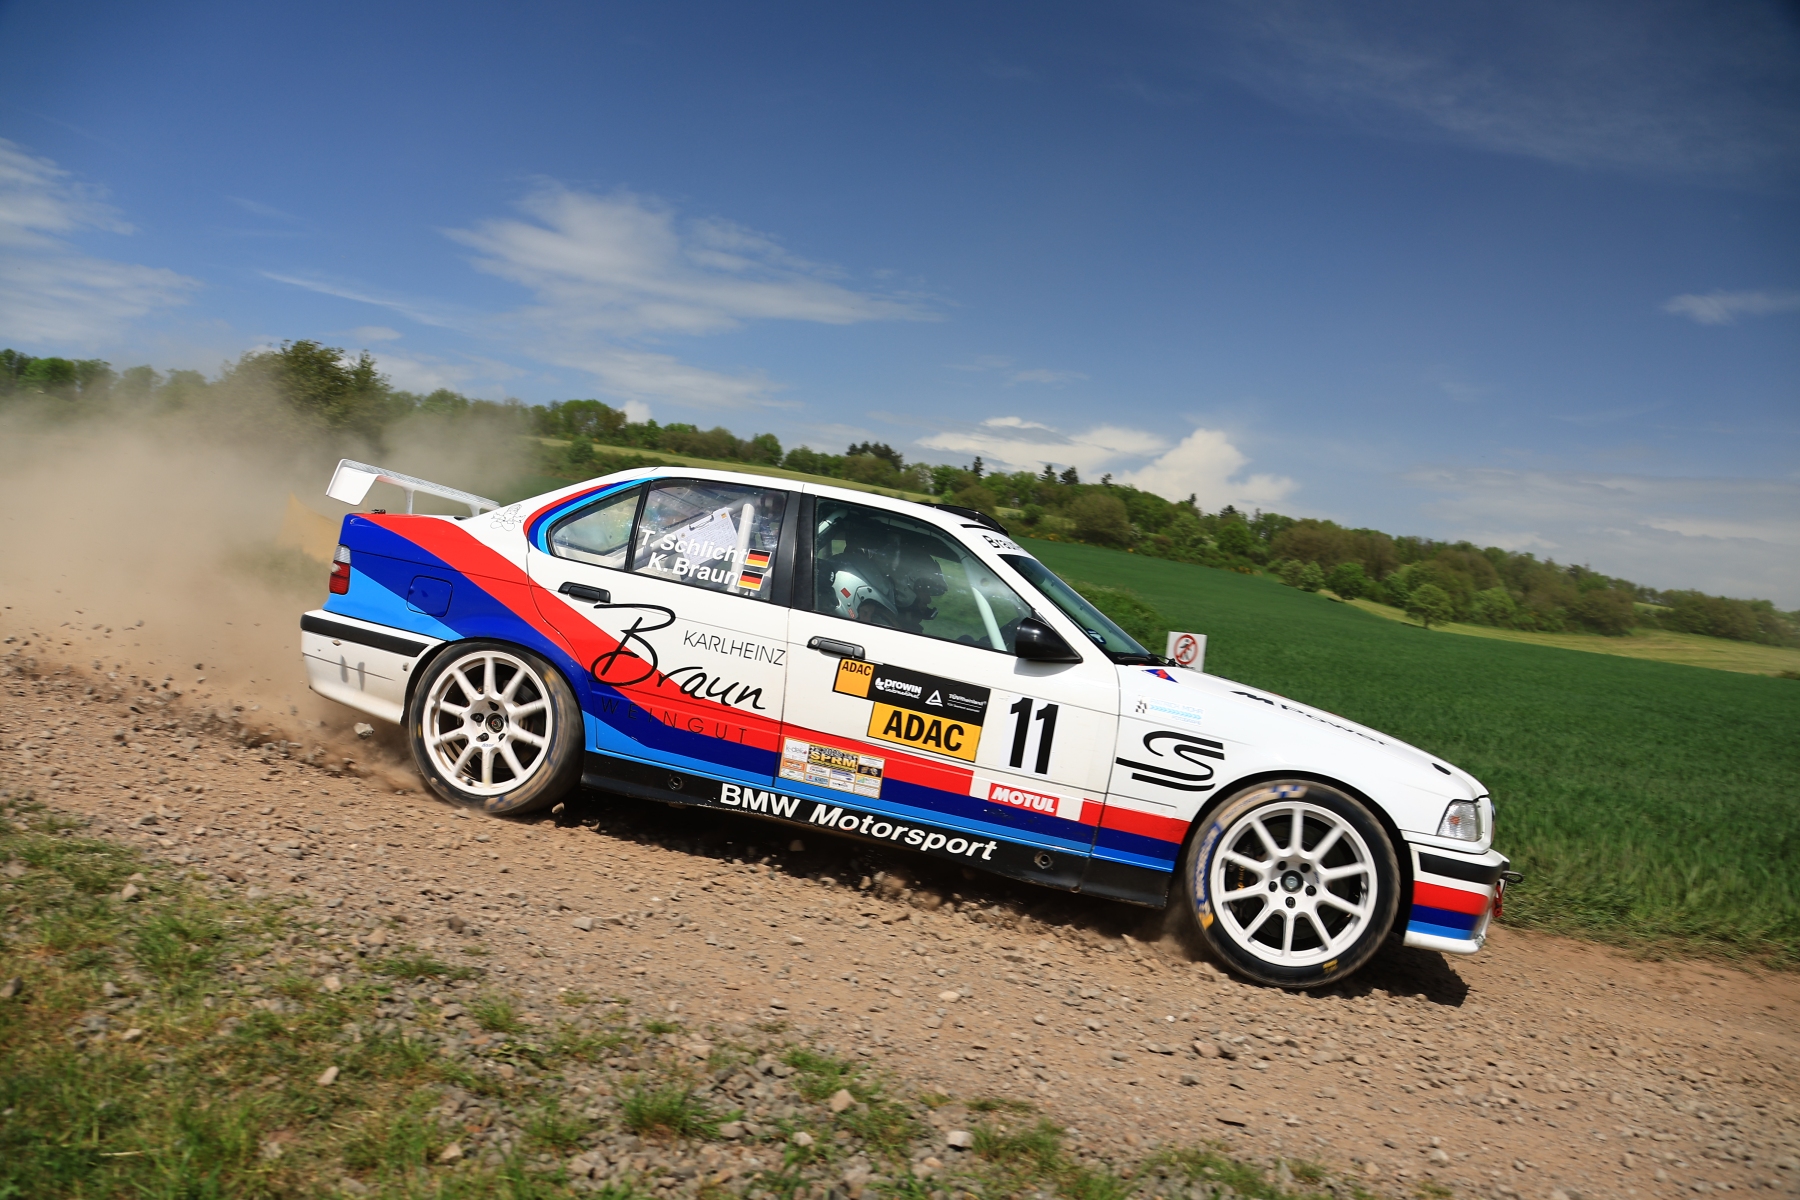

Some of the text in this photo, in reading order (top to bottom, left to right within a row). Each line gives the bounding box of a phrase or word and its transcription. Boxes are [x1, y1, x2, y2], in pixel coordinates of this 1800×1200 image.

[641, 529, 747, 564] T. Schlicht
[647, 552, 738, 586] K. Braun
[591, 604, 765, 709] Braun
[683, 630, 786, 666] KARLHEINZ
[841, 661, 872, 676] ADAC
[602, 697, 747, 743] WEINGUT
[882, 710, 964, 752] ADAC
[1010, 697, 1059, 775] 11
[810, 751, 856, 768] SPRM
[991, 787, 1056, 813] MOTUL
[720, 783, 997, 861] BMW Motorsport
